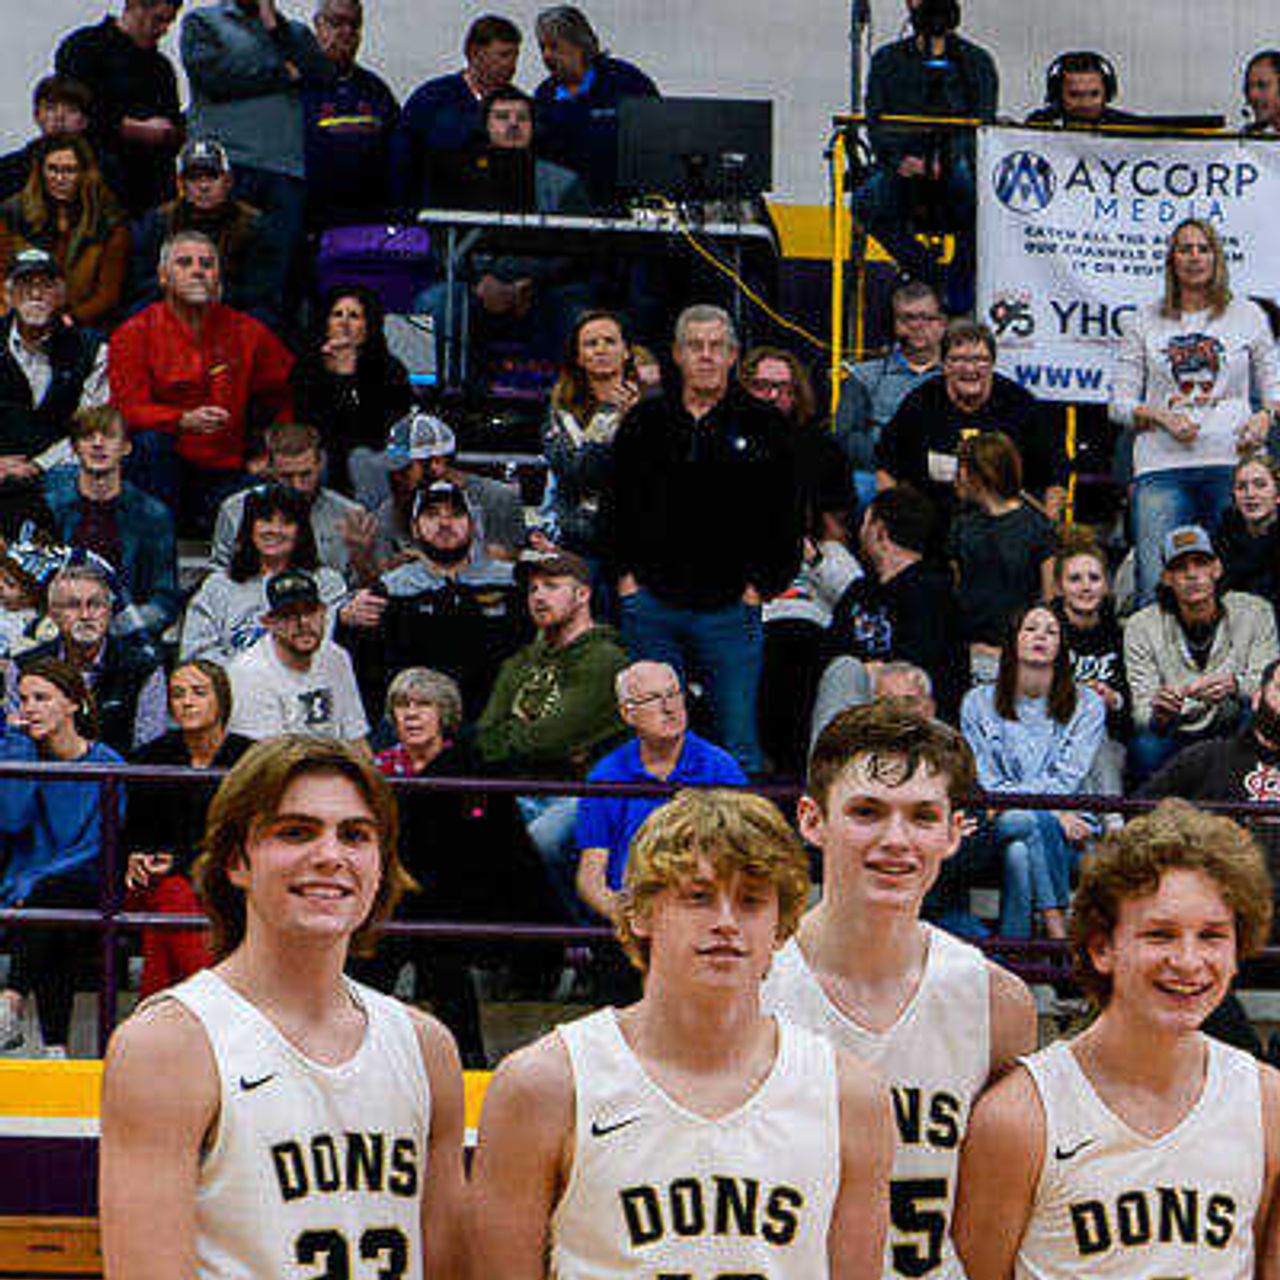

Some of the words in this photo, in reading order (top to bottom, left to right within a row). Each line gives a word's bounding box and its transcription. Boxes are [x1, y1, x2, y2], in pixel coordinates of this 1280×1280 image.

[1064, 159, 1259, 197] AYCORP
[1095, 198, 1225, 222] MEDIA
[270, 1131, 419, 1202] DONS
[618, 1174, 804, 1248] DONS
[1069, 1186, 1237, 1256] DONS
